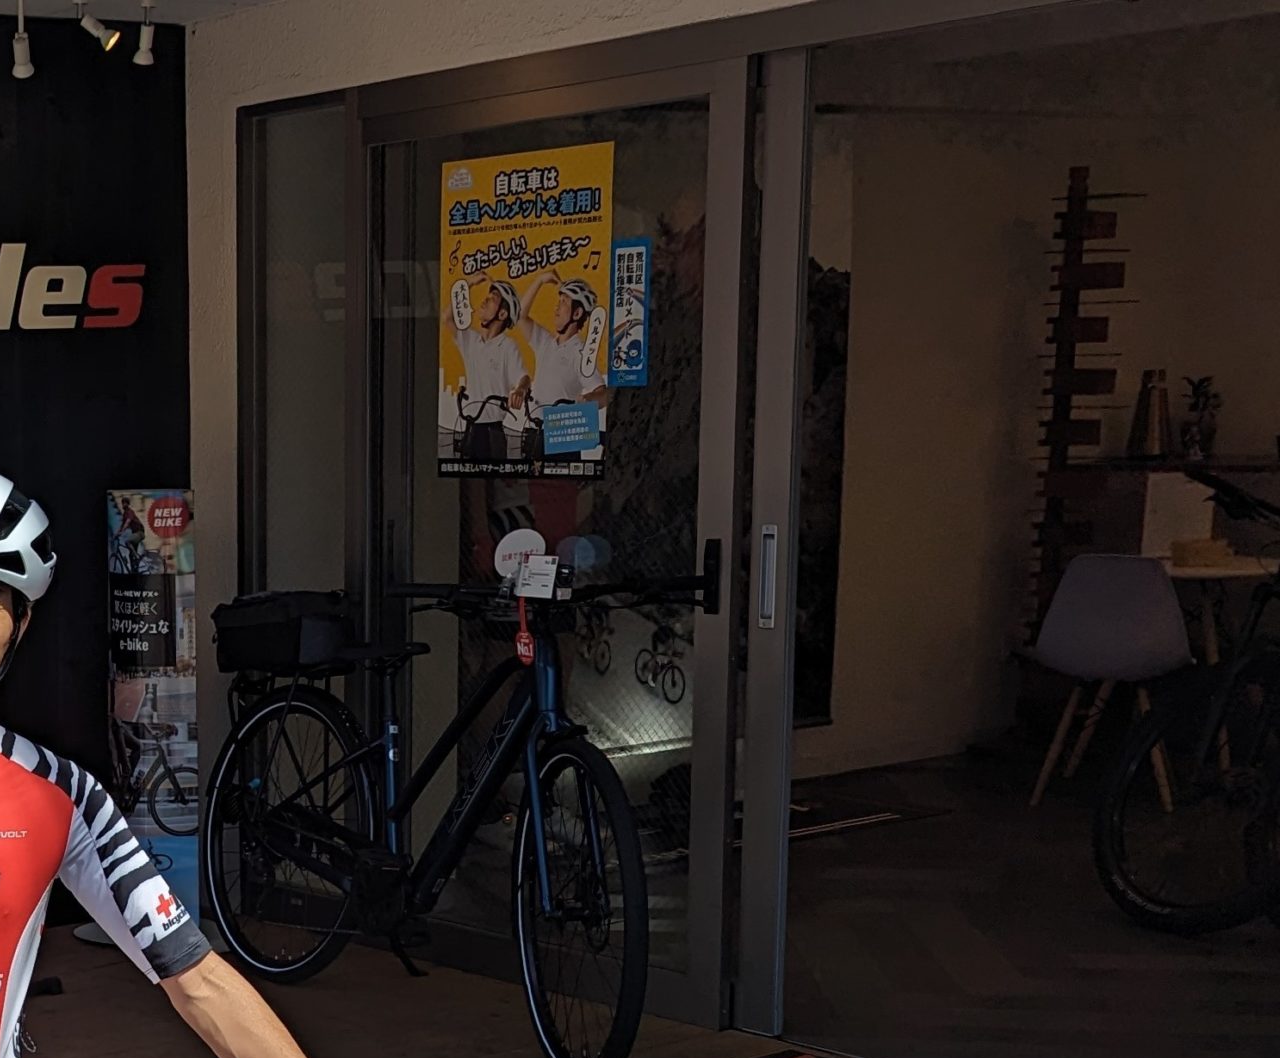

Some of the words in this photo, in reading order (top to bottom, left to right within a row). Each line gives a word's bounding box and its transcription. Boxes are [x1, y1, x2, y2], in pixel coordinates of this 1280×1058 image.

[495, 167, 559, 196] 自転車は
[462, 235, 527, 275] あたらしい
[585, 315, 602, 367] ヘルメット
[153, 516, 183, 528] BIKE
[154, 508, 183, 519] NEW
[111, 618, 170, 635] スタイリッシュな
[119, 637, 150, 652] e-bike
